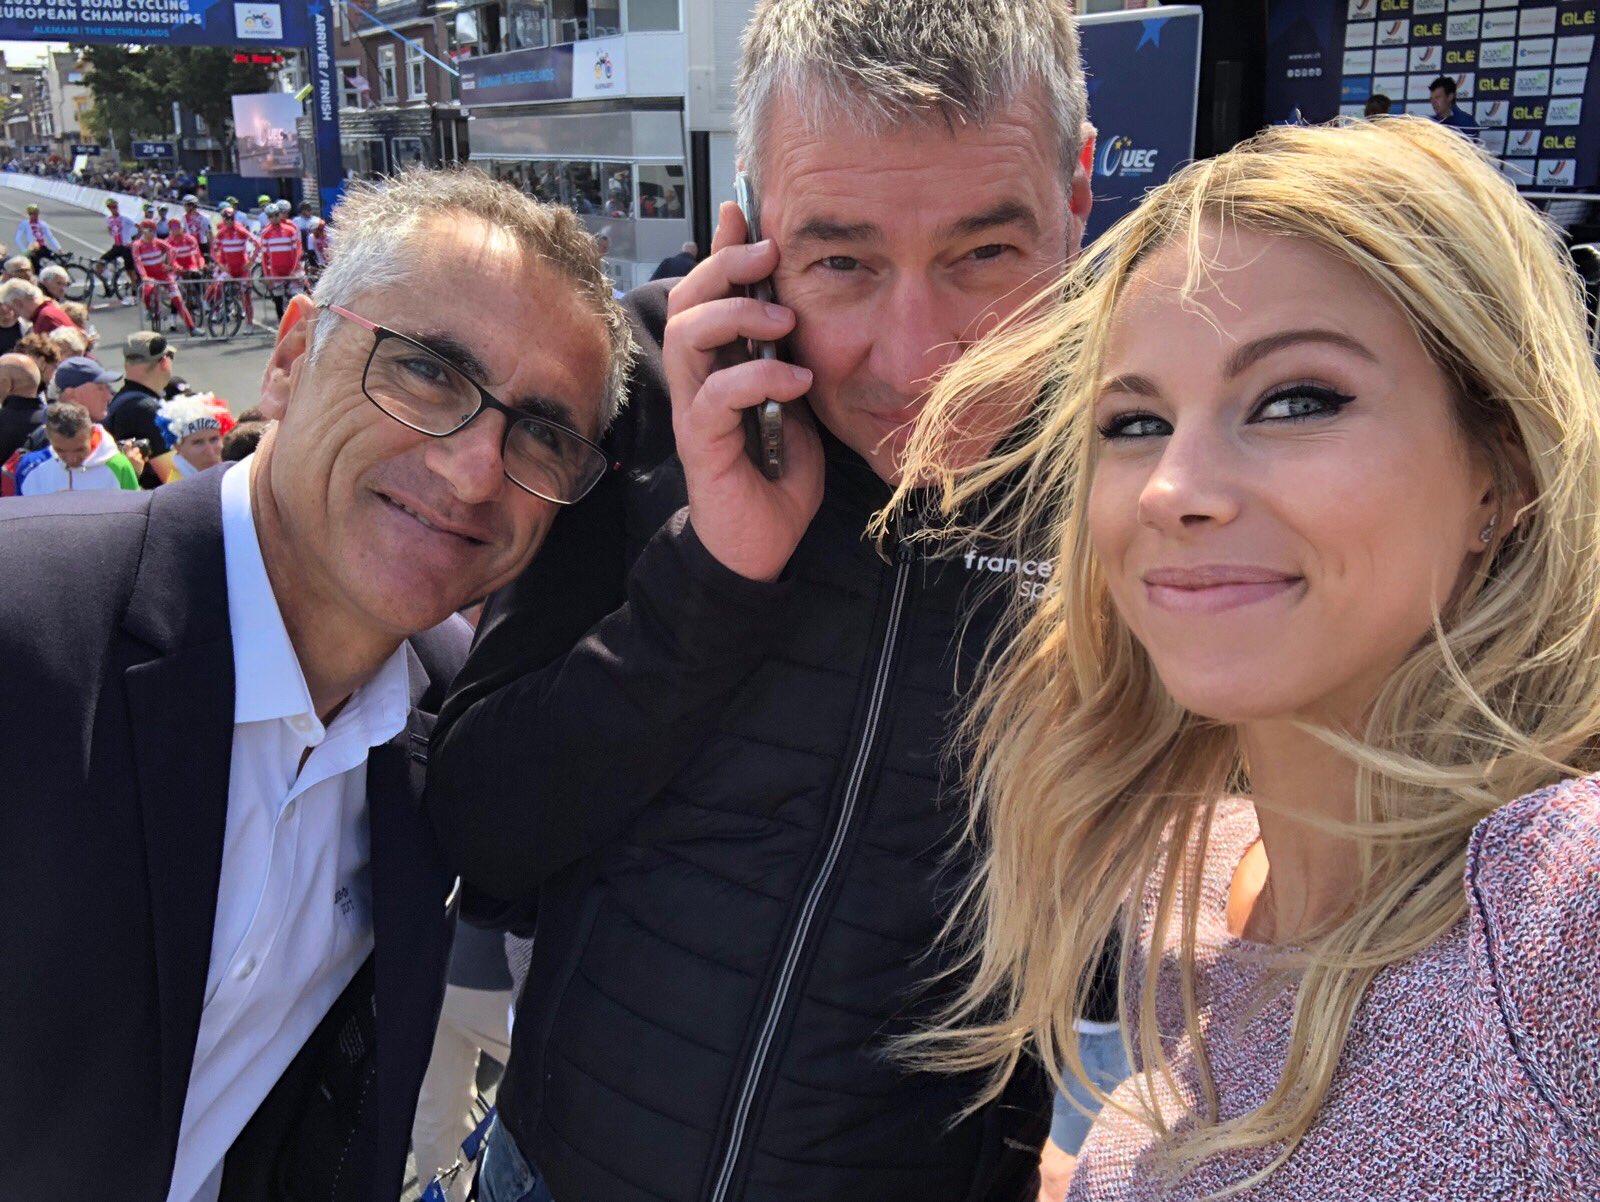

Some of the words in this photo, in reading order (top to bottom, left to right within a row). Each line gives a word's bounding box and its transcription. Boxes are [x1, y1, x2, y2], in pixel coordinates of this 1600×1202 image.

[80, 0, 123, 8] ROAD
[126, 0, 190, 11] CYCLING
[81, 10, 203, 25] CHAMPIONSHIPS
[320, 80, 332, 120] FINISH
[1121, 149, 1158, 168] UEC
[964, 549, 1054, 578] france
